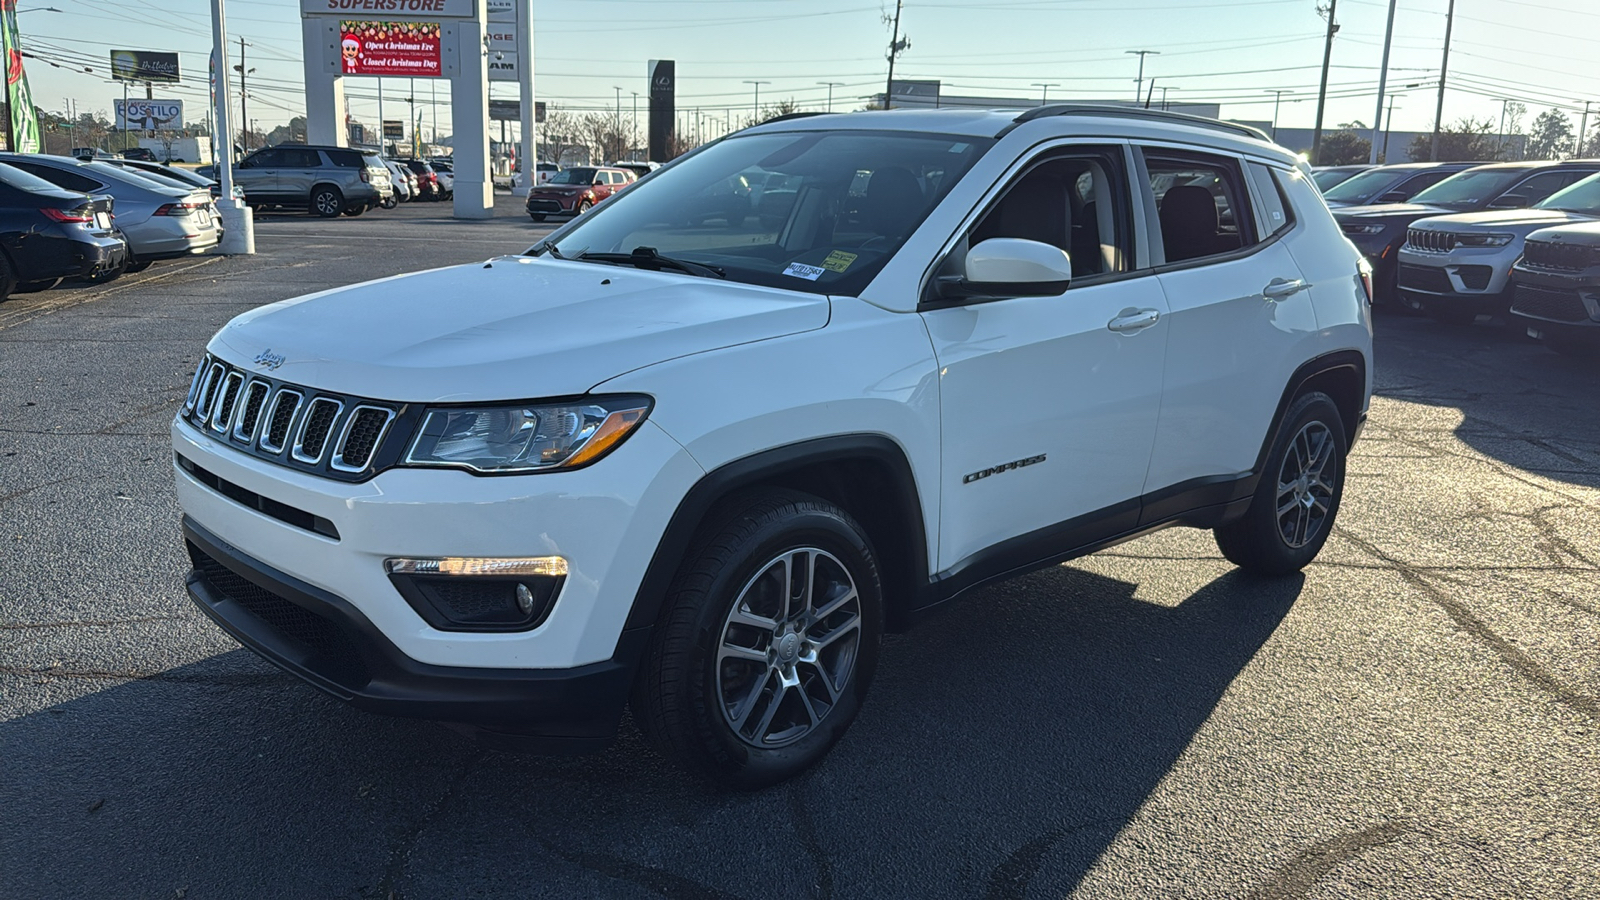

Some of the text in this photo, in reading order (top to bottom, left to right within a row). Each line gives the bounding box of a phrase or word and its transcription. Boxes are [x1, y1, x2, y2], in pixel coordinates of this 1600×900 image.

[328, 0, 444, 11] SUPERSTORE
[365, 41, 434, 51] Open Christmas Eve
[362, 57, 438, 69] Closed Christmas Day
[489, 62, 514, 70] AM
[253, 348, 286, 372] Jeep
[962, 453, 1047, 484] COMPASS
